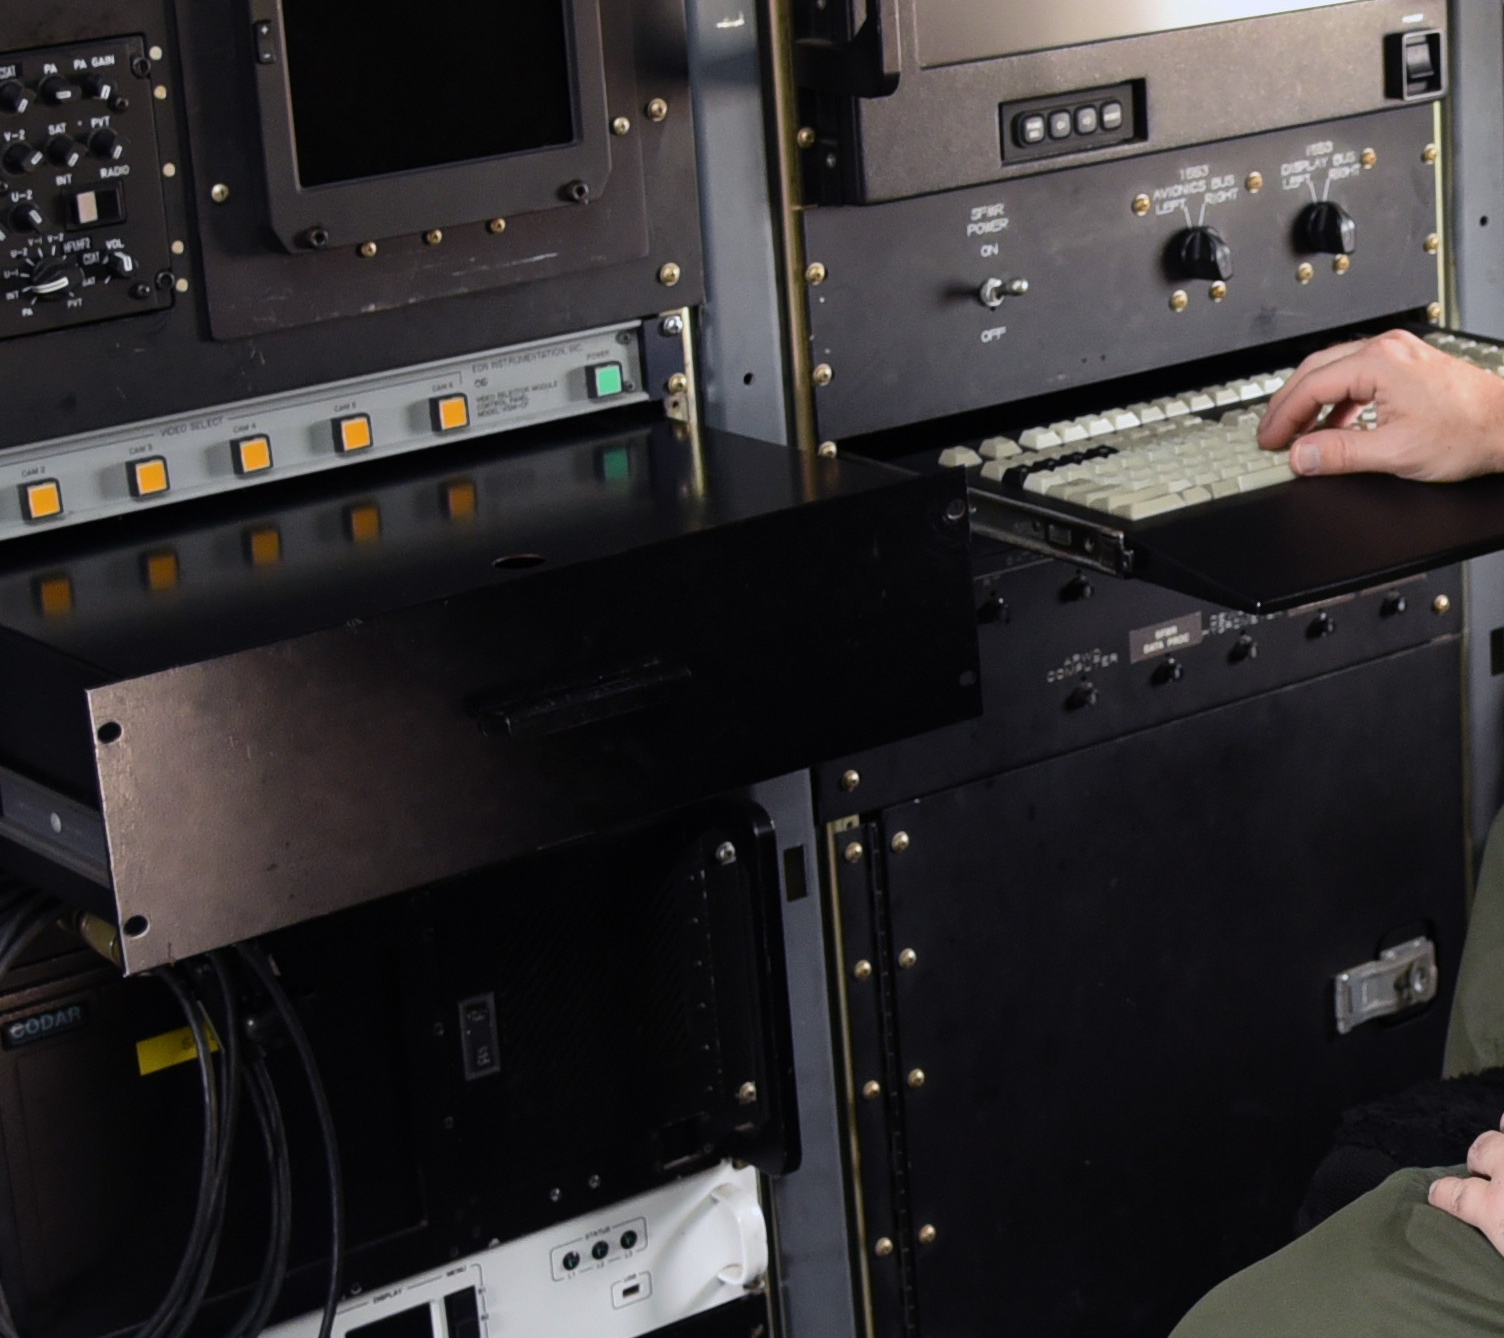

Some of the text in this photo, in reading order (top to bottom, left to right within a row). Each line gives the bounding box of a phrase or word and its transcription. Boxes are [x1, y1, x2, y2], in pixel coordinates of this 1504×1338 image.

[44, 63, 58, 74] PA
[73, 55, 115, 70] PA GAIN
[90, 116, 110, 128] PVT
[4, 129, 26, 142] V-2
[48, 123, 67, 136] SAT
[55, 165, 130, 186] INT RADIO
[1282, 173, 1312, 190] LEFT
[1153, 174, 1235, 202] AVIONICS BUS
[11, 190, 33, 202] U-2
[1155, 187, 1239, 216] LEFT RIGHT
[967, 217, 1009, 237] POWER
[106, 239, 125, 251] VOL
[980, 244, 999, 257] ON
[981, 326, 1006, 343] OFF
[160, 415, 224, 437] VIDEO SELECT
[129, 445, 146, 455] CAM
[21, 468, 39, 478] CAM
